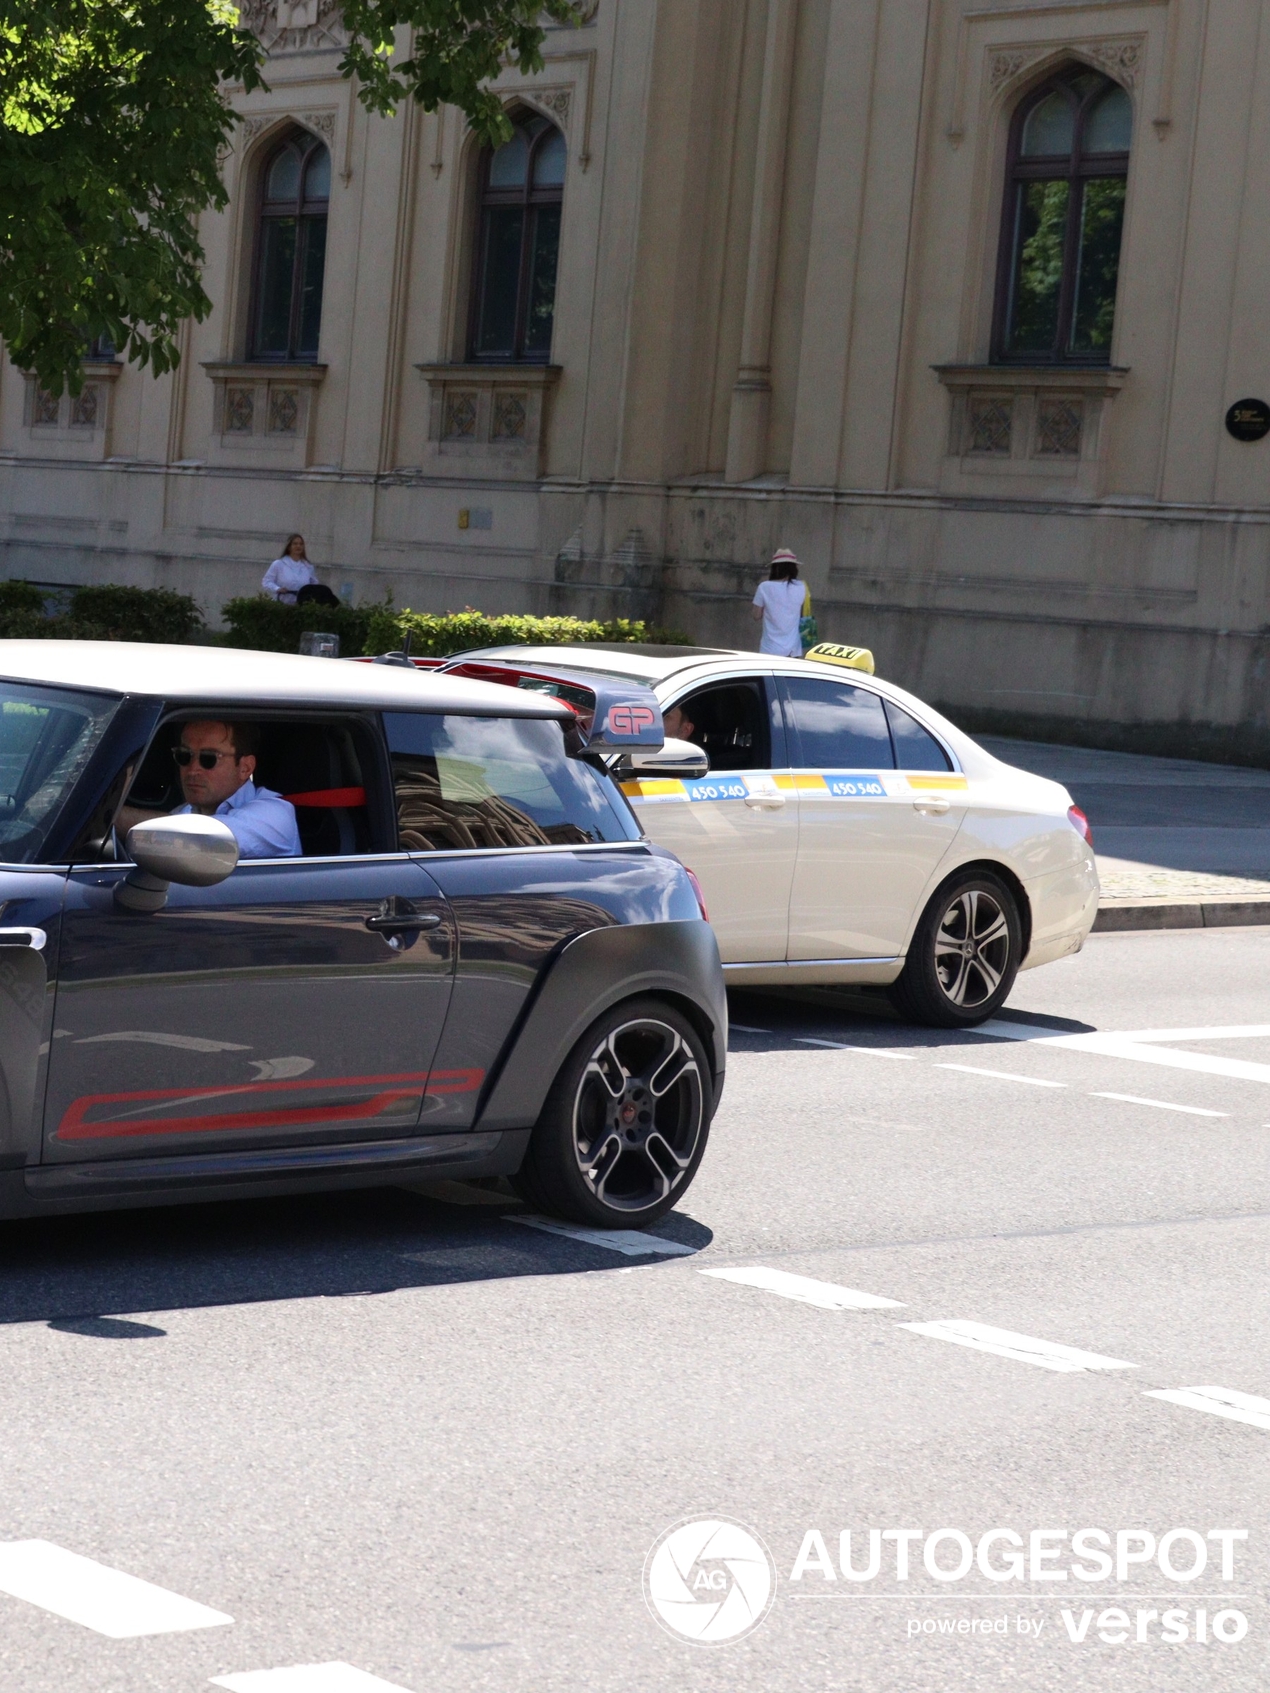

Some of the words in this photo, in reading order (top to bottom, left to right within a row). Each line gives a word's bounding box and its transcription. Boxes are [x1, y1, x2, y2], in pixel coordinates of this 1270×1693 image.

[817, 644, 860, 659] TAXI
[608, 706, 654, 735] GP
[692, 785, 718, 800] 450
[719, 784, 746, 799] 540
[832, 782, 857, 795] 450
[857, 782, 882, 795] 540
